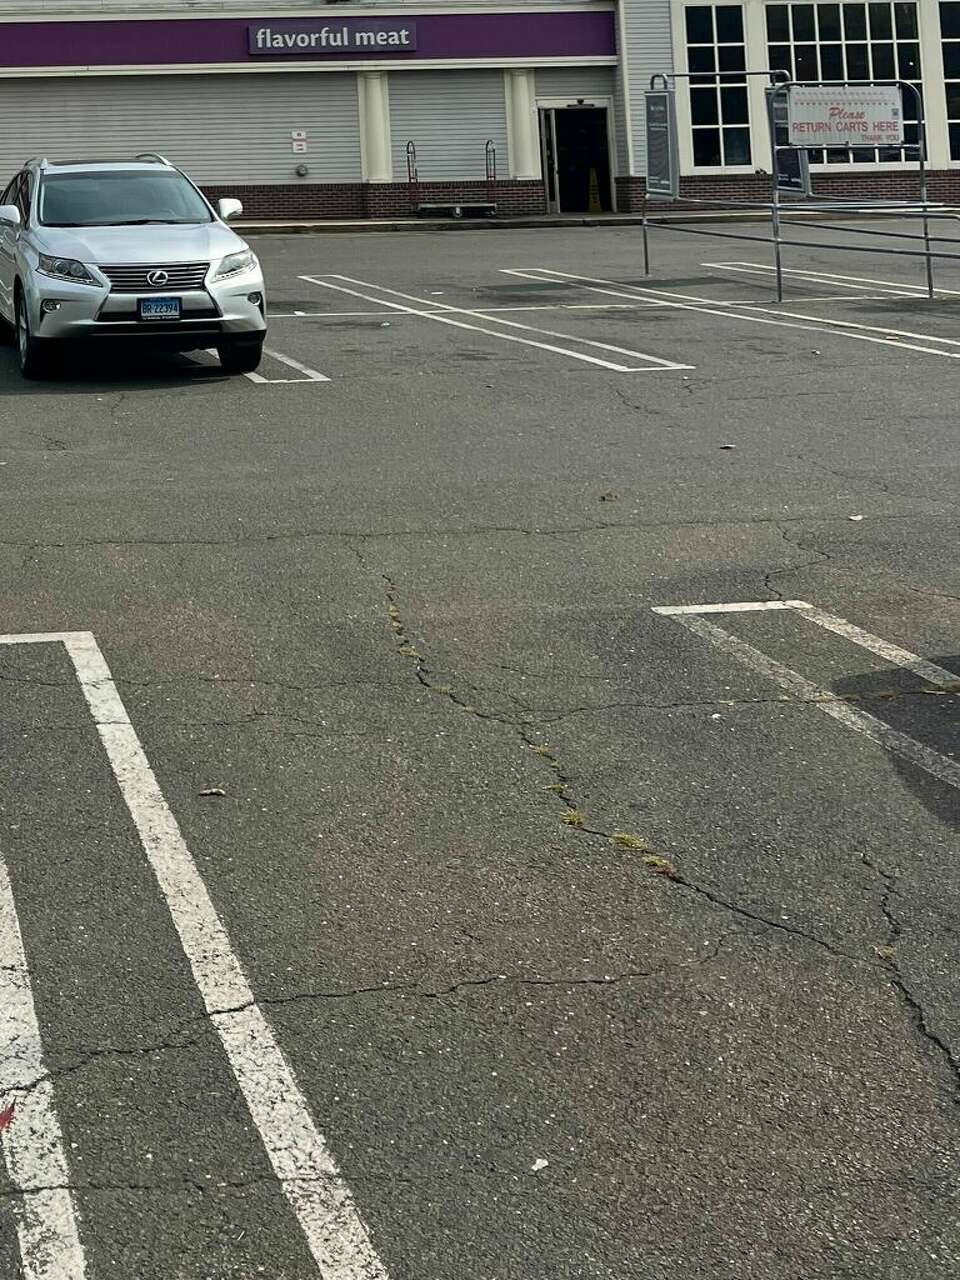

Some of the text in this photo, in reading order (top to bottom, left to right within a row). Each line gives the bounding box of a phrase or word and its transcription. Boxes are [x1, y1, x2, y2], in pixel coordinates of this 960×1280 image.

[256, 27, 410, 48] flavorful meat
[828, 106, 866, 120] Please
[792, 122, 832, 133] RETURN
[836, 121, 868, 132] CARTS
[873, 120, 900, 132] HERE
